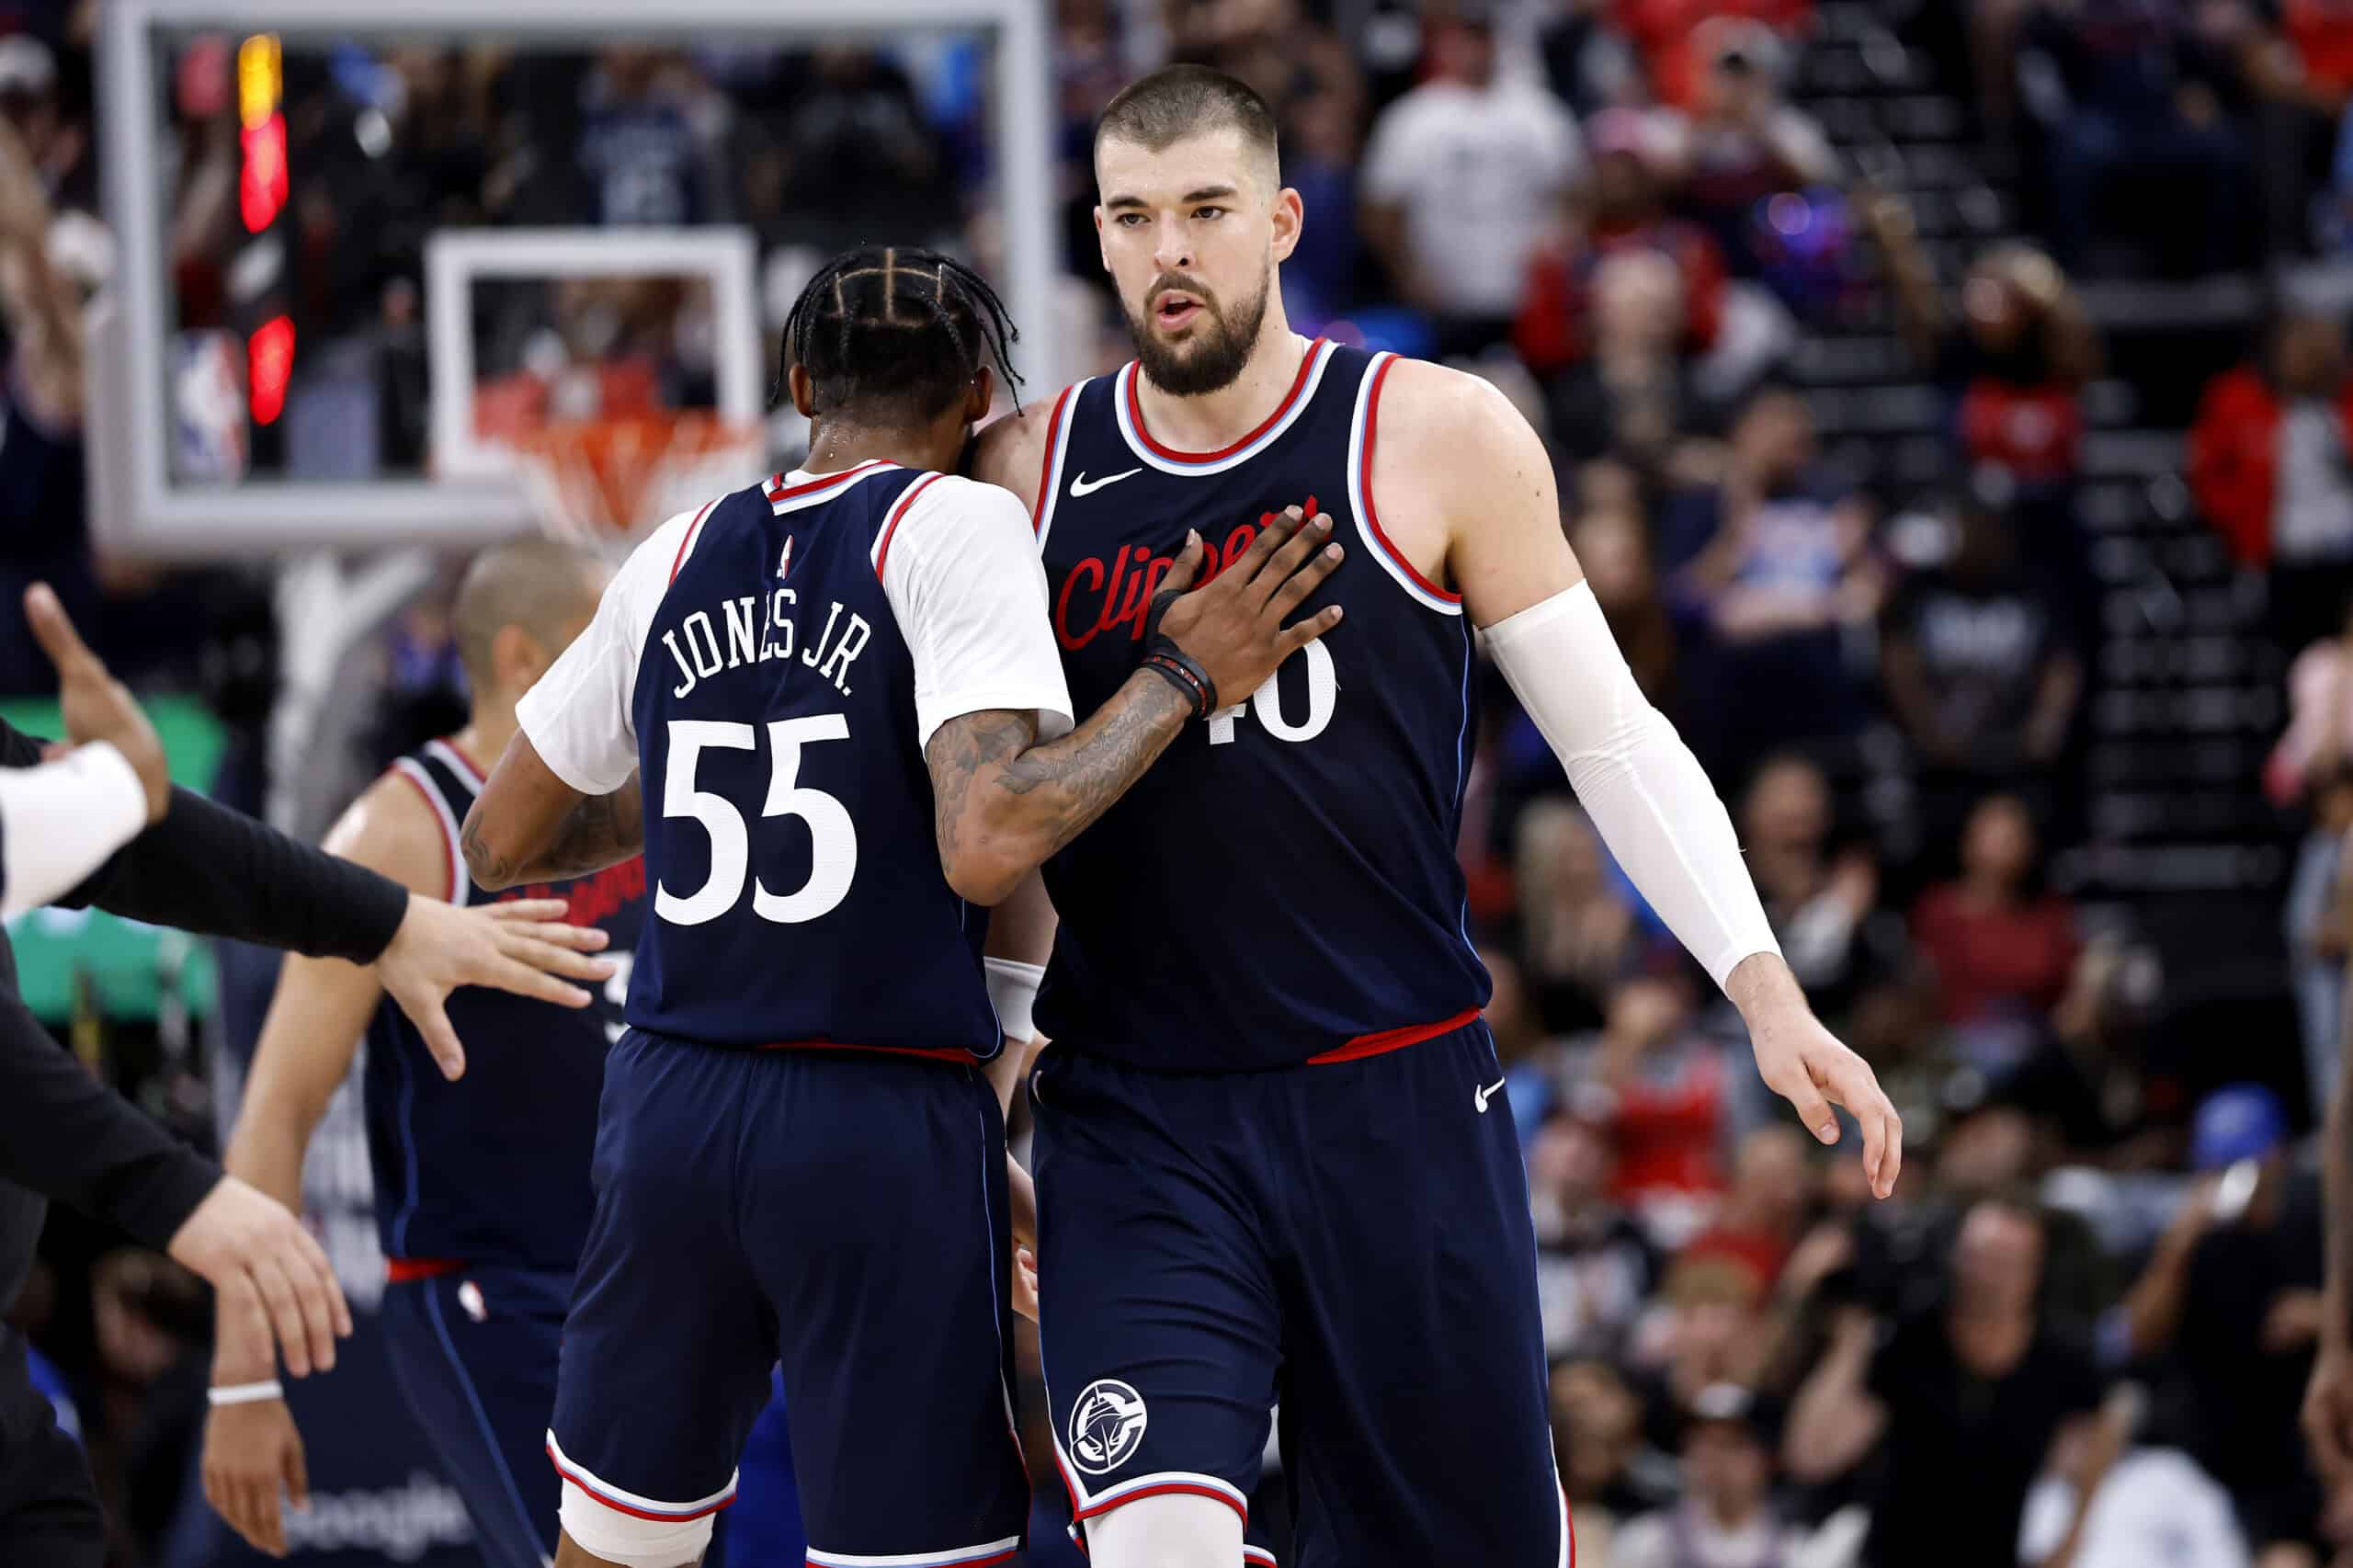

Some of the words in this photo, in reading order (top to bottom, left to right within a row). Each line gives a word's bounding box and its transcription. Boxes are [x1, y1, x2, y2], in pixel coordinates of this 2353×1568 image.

[1055, 494, 1333, 652] Clipe
[801, 601, 871, 697] JR.
[1210, 636, 1336, 745] 0
[654, 713, 858, 926] 55
